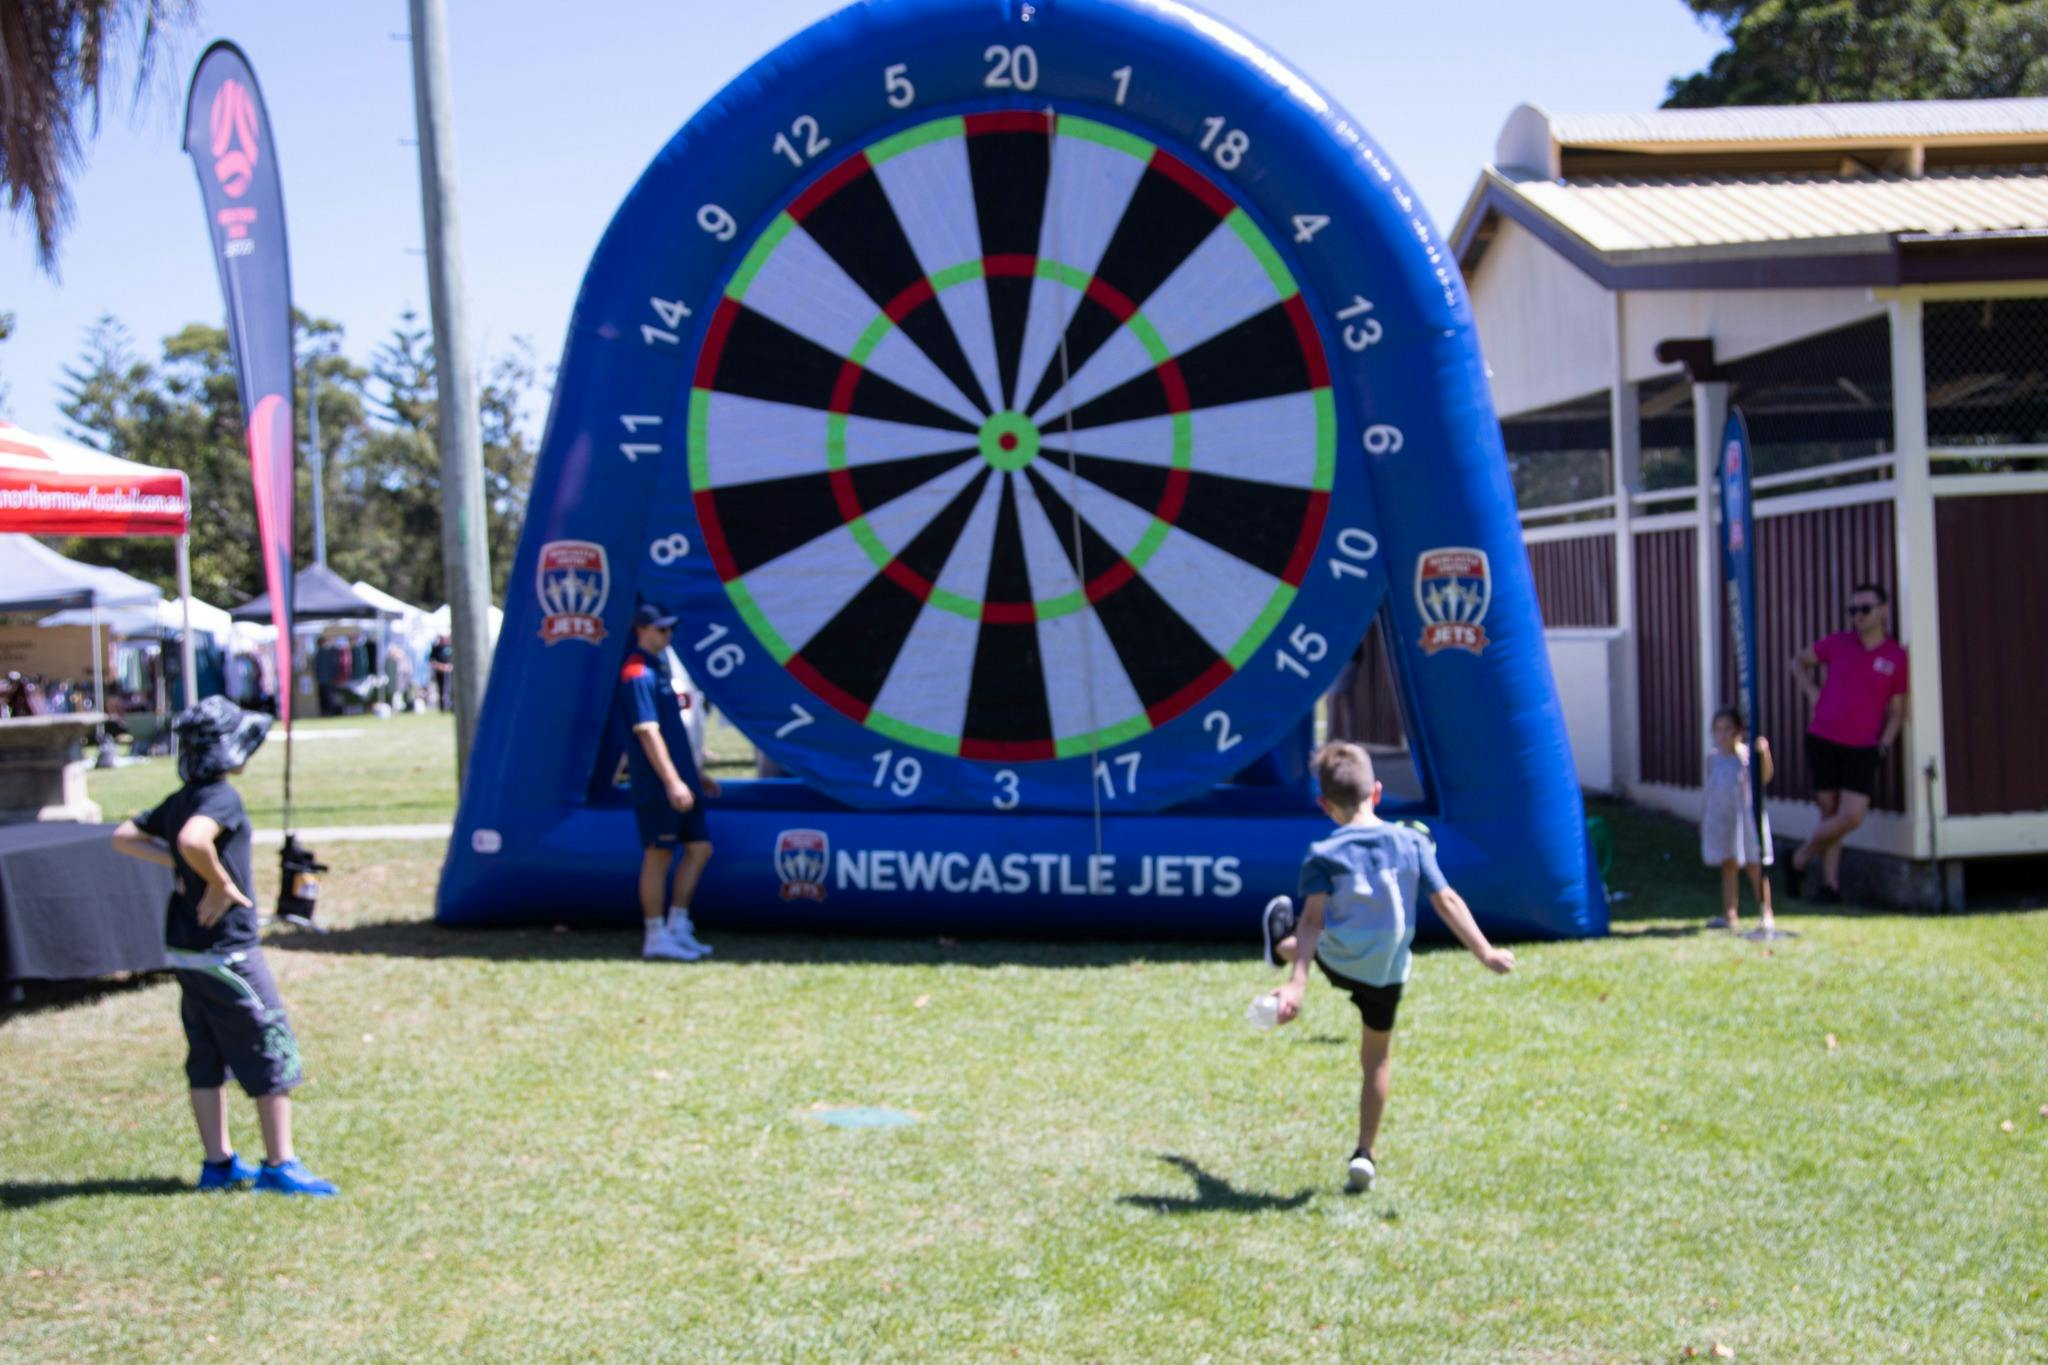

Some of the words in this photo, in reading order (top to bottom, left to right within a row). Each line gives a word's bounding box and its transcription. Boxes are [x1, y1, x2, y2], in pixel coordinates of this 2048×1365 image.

[884, 63, 915, 109] 5
[984, 44, 1039, 91] 20
[1112, 65, 1132, 105] 1
[773, 115, 831, 167] 12
[1200, 116, 1250, 170] 18
[696, 203, 737, 241] 9
[1292, 214, 1330, 242] 4
[640, 297, 691, 344] 14
[1336, 295, 1383, 352] 13
[619, 414, 662, 461] 11
[1363, 424, 1404, 455] 6
[649, 533, 690, 565] 8
[1329, 527, 1378, 579] 10
[551, 618, 596, 635] JETS
[1432, 626, 1477, 645] JETS
[694, 623, 745, 678] 16
[1275, 624, 1328, 678] 15
[775, 703, 814, 738] 7
[1203, 710, 1242, 753] 2
[873, 749, 922, 797] 19
[992, 769, 1020, 810] 3
[1096, 752, 1142, 799] 17
[836, 850, 1116, 894] NEWCASTLE
[1129, 855, 1242, 897] JETS
